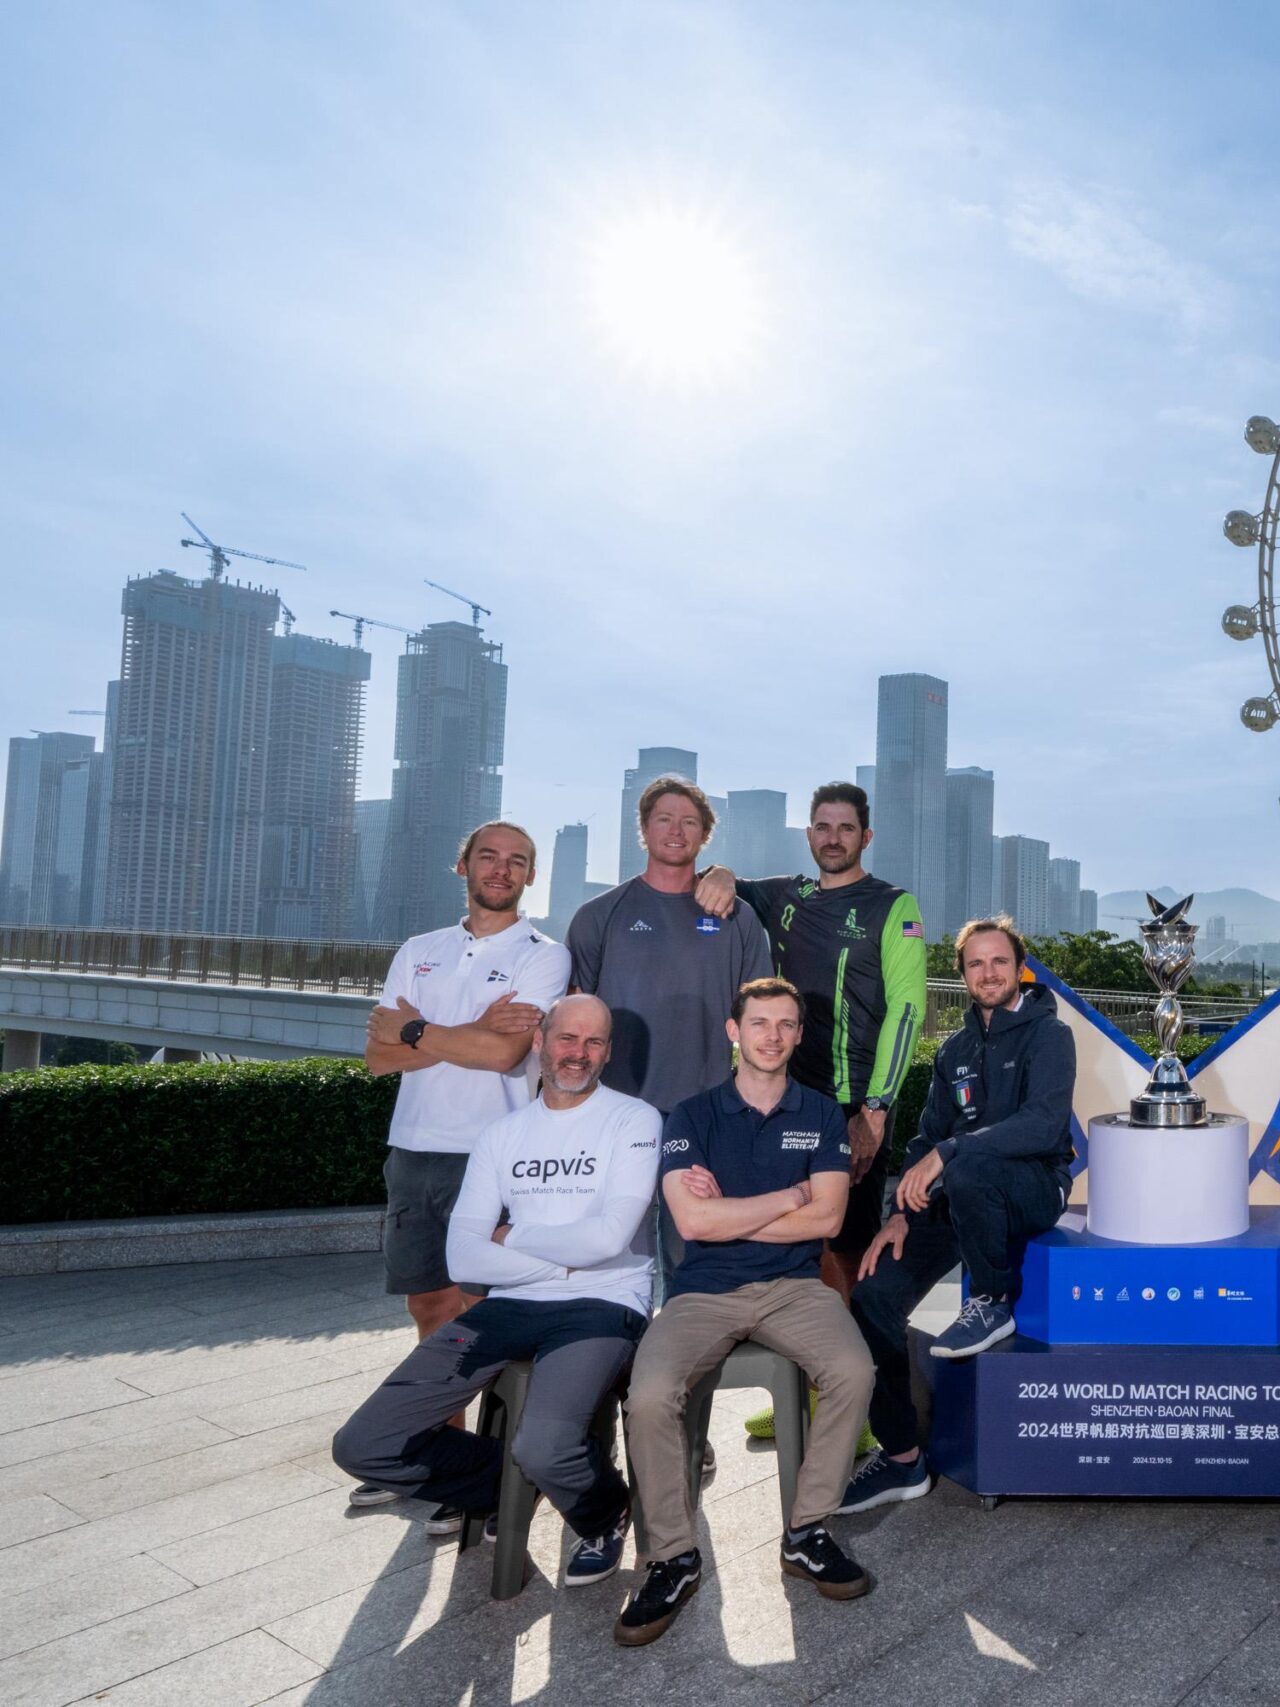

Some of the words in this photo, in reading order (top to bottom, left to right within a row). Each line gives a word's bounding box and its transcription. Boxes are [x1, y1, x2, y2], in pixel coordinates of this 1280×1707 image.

[512, 1150, 596, 1184] capvis
[510, 1188, 530, 1196] Swiss
[556, 1186, 574, 1194] Race
[576, 1186, 596, 1194] Team
[1018, 1383, 1058, 1399] 2024
[1063, 1383, 1125, 1399] WORLD
[1129, 1384, 1190, 1400] MATCH
[1195, 1385, 1258, 1401] RACING
[1202, 1406, 1235, 1418] FINAL
[1132, 1456, 1173, 1465] 2024.12.10-15
